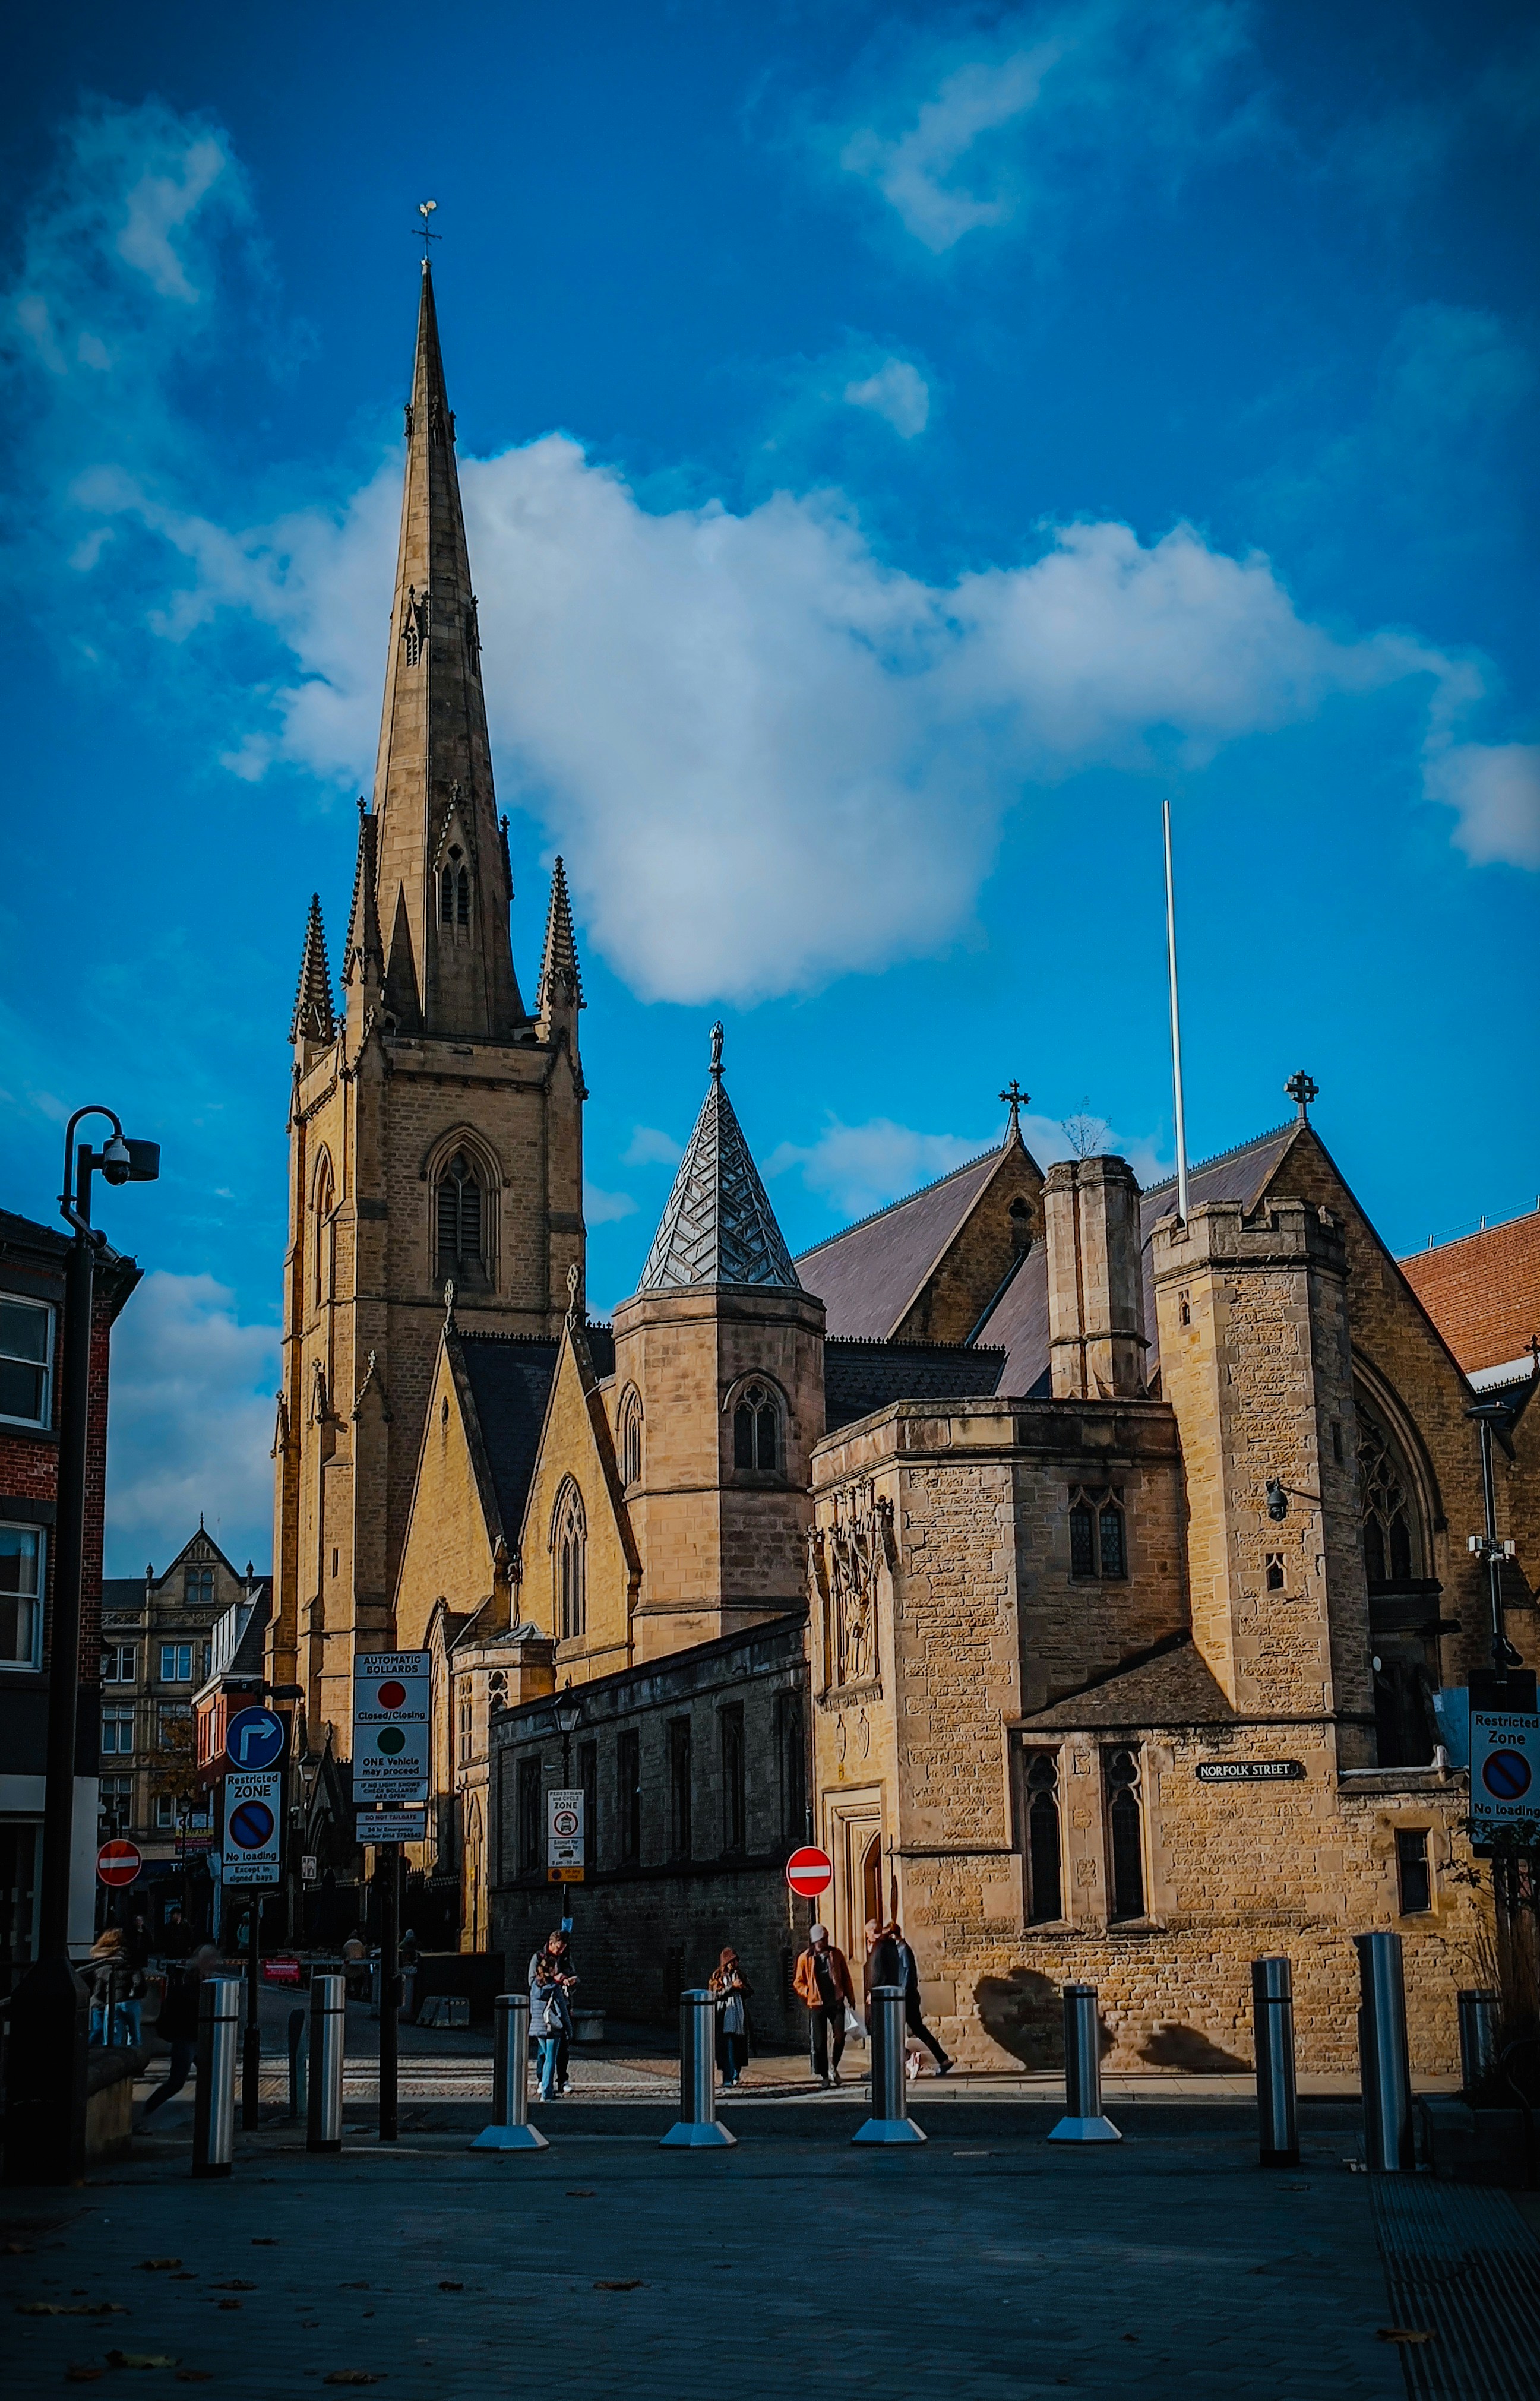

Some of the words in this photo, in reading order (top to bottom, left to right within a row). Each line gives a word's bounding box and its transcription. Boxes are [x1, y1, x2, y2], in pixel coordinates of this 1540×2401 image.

[363, 1656, 422, 1665] AUTOMATIC
[366, 1665, 419, 1674] BOLLARDS
[358, 1710, 425, 1721] Closed/Closing
[1475, 1714, 1539, 1728] Restricted
[1489, 1730, 1526, 1745] Zone
[363, 1758, 384, 1766] ONE
[387, 1757, 419, 1766] Vehicle
[362, 1768, 381, 1776] may
[383, 1767, 419, 1777] proceed
[1201, 1765, 1250, 1777] NORFOLK
[1252, 1764, 1290, 1775] STREET
[228, 1774, 278, 1785] Restricted
[234, 1785, 271, 1798] ZONE
[1474, 1803, 1491, 1815] No
[1495, 1804, 1540, 1818] loading
[226, 1853, 239, 1861] No
[242, 1852, 276, 1862] loading
